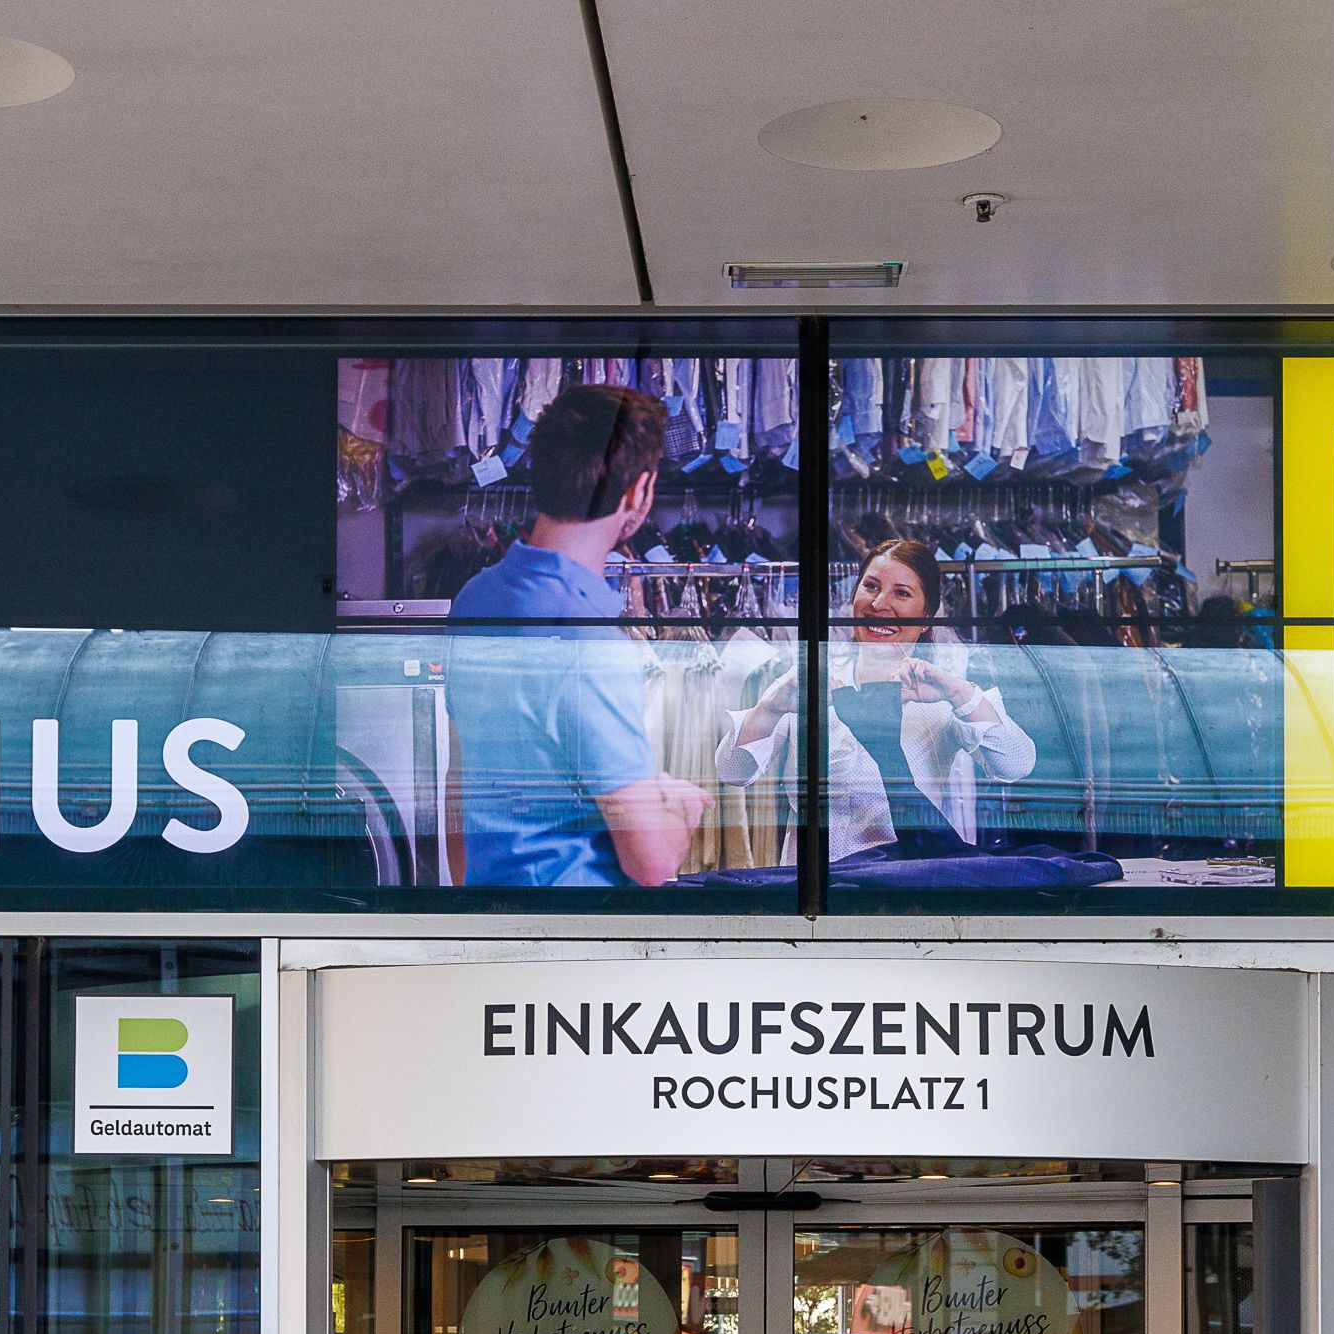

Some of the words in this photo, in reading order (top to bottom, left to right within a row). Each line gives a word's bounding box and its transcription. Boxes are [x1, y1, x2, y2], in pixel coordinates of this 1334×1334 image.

[482, 1000, 1156, 1058] EINKAUFSZENTRUM
[653, 1075, 965, 1110] ROCHUSPLATZ
[976, 1077, 989, 1110] 1
[90, 1119, 212, 1137] Geldautomat
[526, 1282, 611, 1324] Bunter
[921, 1274, 1009, 1315] Bunter
